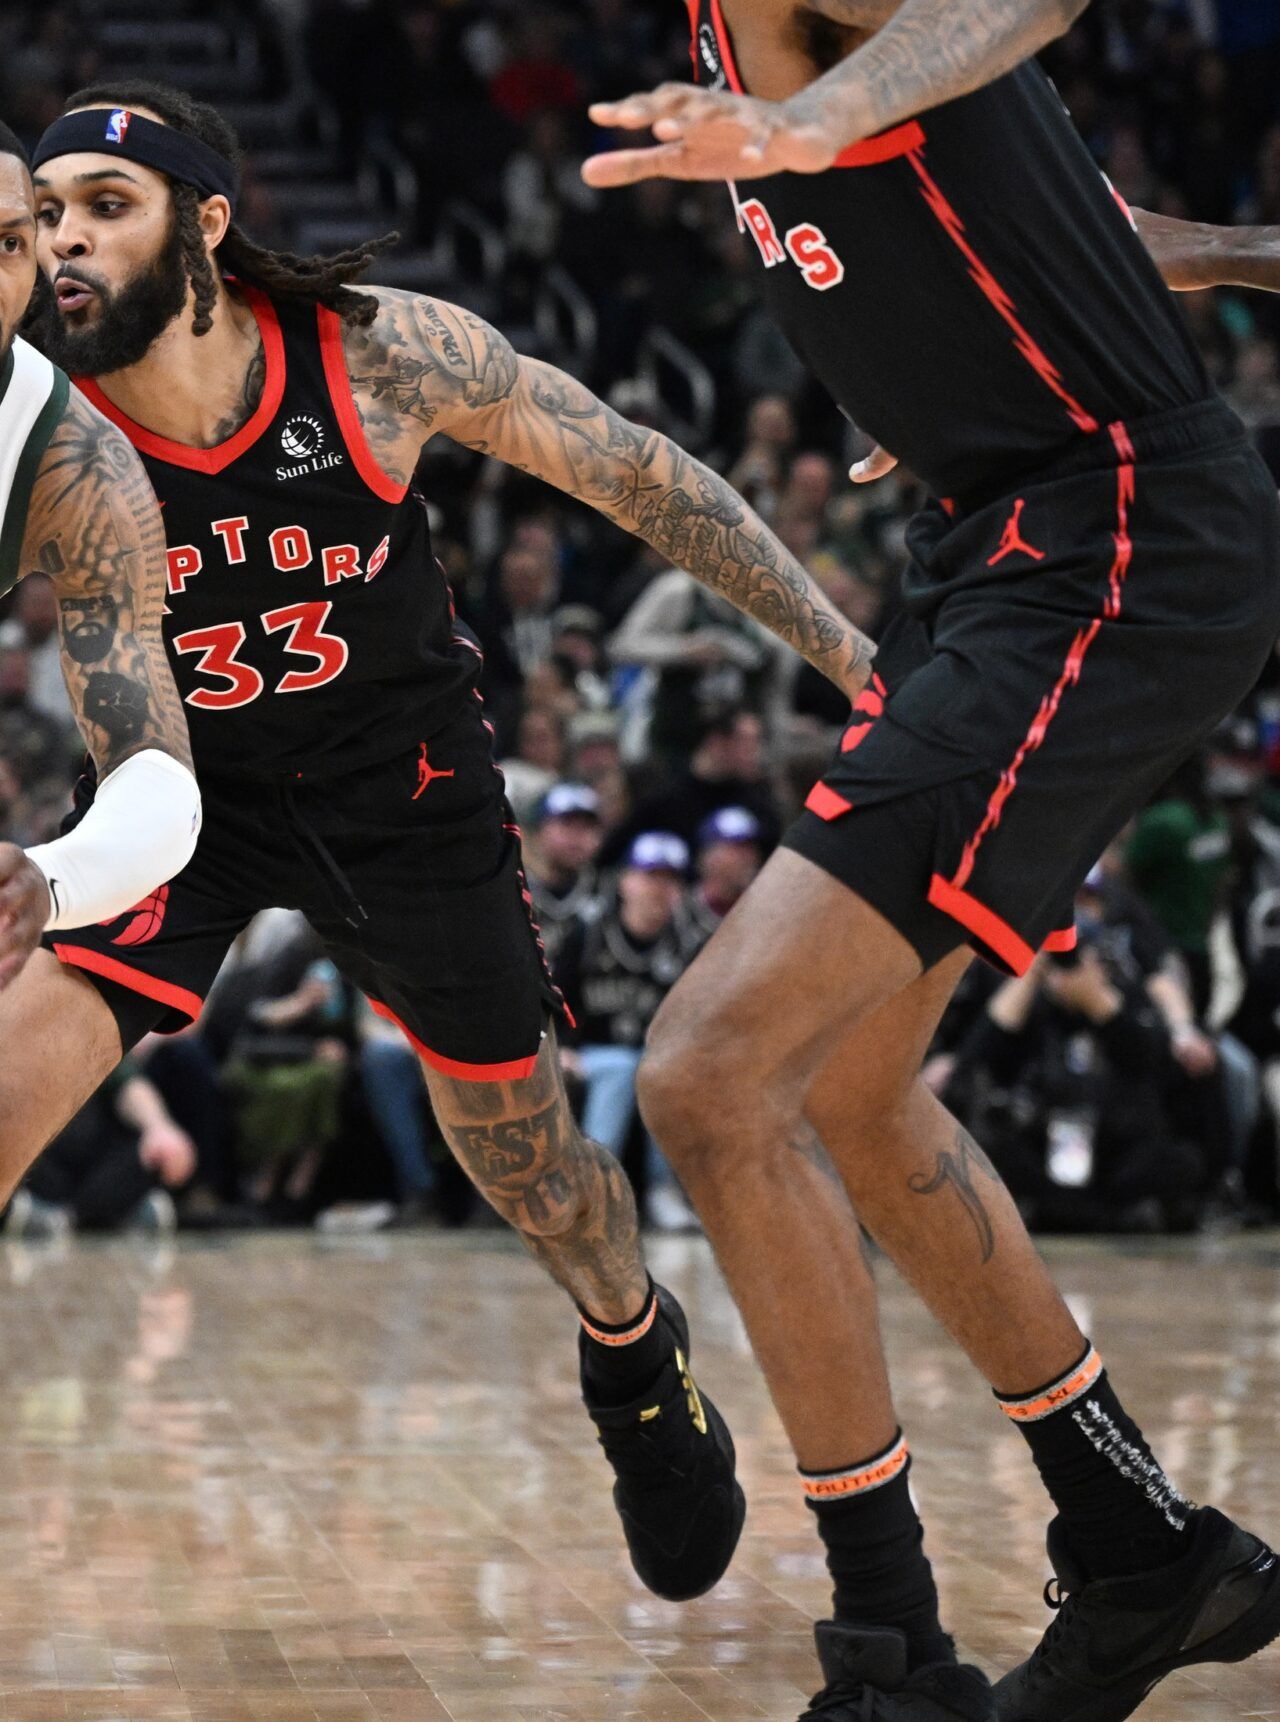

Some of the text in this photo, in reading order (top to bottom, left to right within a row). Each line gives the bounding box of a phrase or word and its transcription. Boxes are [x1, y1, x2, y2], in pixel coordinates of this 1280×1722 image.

[275, 451, 344, 481] Sun Life
[165, 516, 390, 595] PTORS
[172, 601, 349, 710] 33
